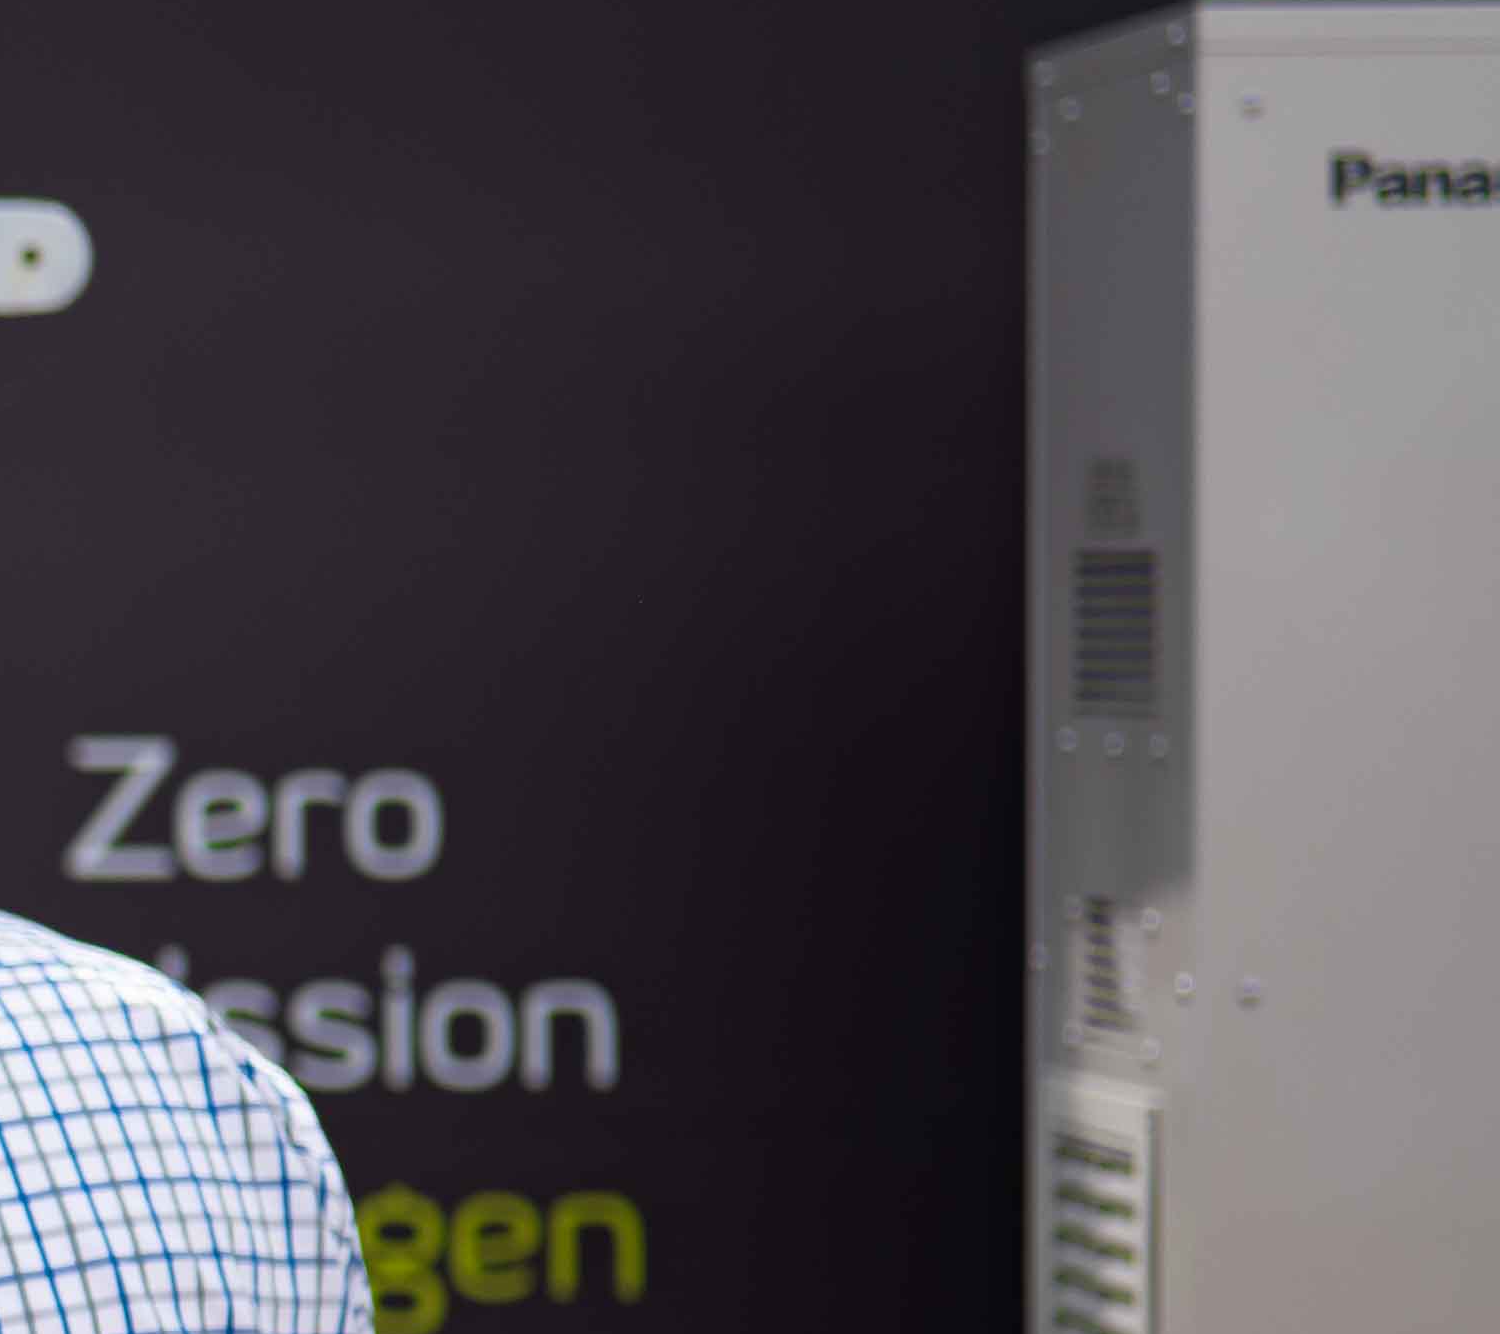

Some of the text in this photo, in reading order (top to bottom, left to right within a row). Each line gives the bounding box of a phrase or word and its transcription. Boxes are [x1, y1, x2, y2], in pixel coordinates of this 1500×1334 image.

[1328, 148, 1500, 207] Pana
[66, 734, 443, 881] Zero
[158, 944, 620, 1092] ssion
